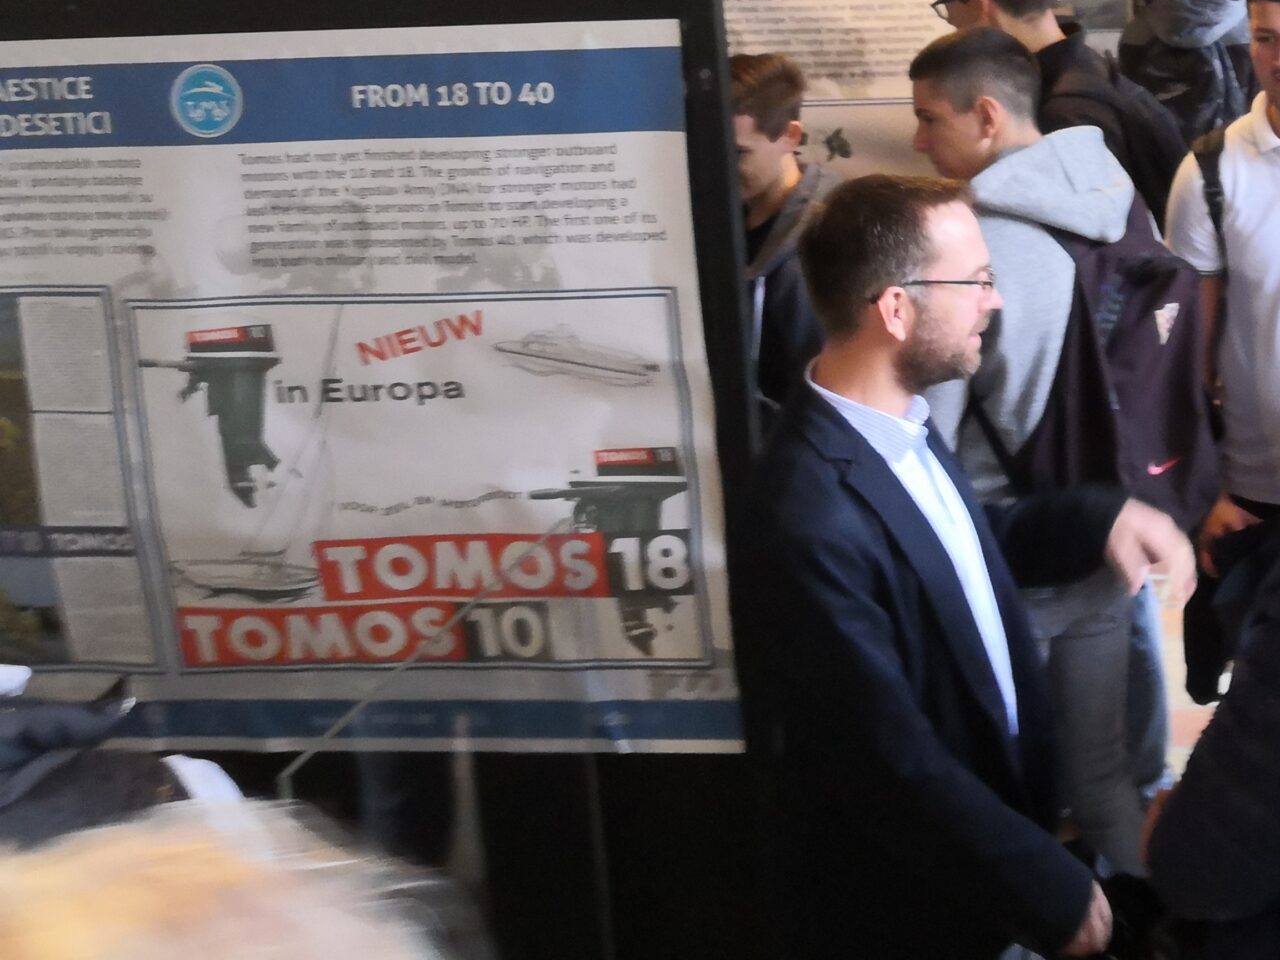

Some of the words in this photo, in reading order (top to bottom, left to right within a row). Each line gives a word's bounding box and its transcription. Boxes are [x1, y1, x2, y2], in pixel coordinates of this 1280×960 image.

[351, 83, 430, 108] FROM
[435, 82, 469, 107] 18
[473, 81, 511, 105] TO
[518, 81, 555, 105] 40
[356, 310, 482, 366] NIEUW
[274, 379, 308, 403] in
[321, 378, 465, 405] Europa
[325, 540, 599, 595] TOMOS
[609, 535, 692, 591] 18
[184, 607, 457, 662] TOMOS
[465, 605, 546, 659] 10
